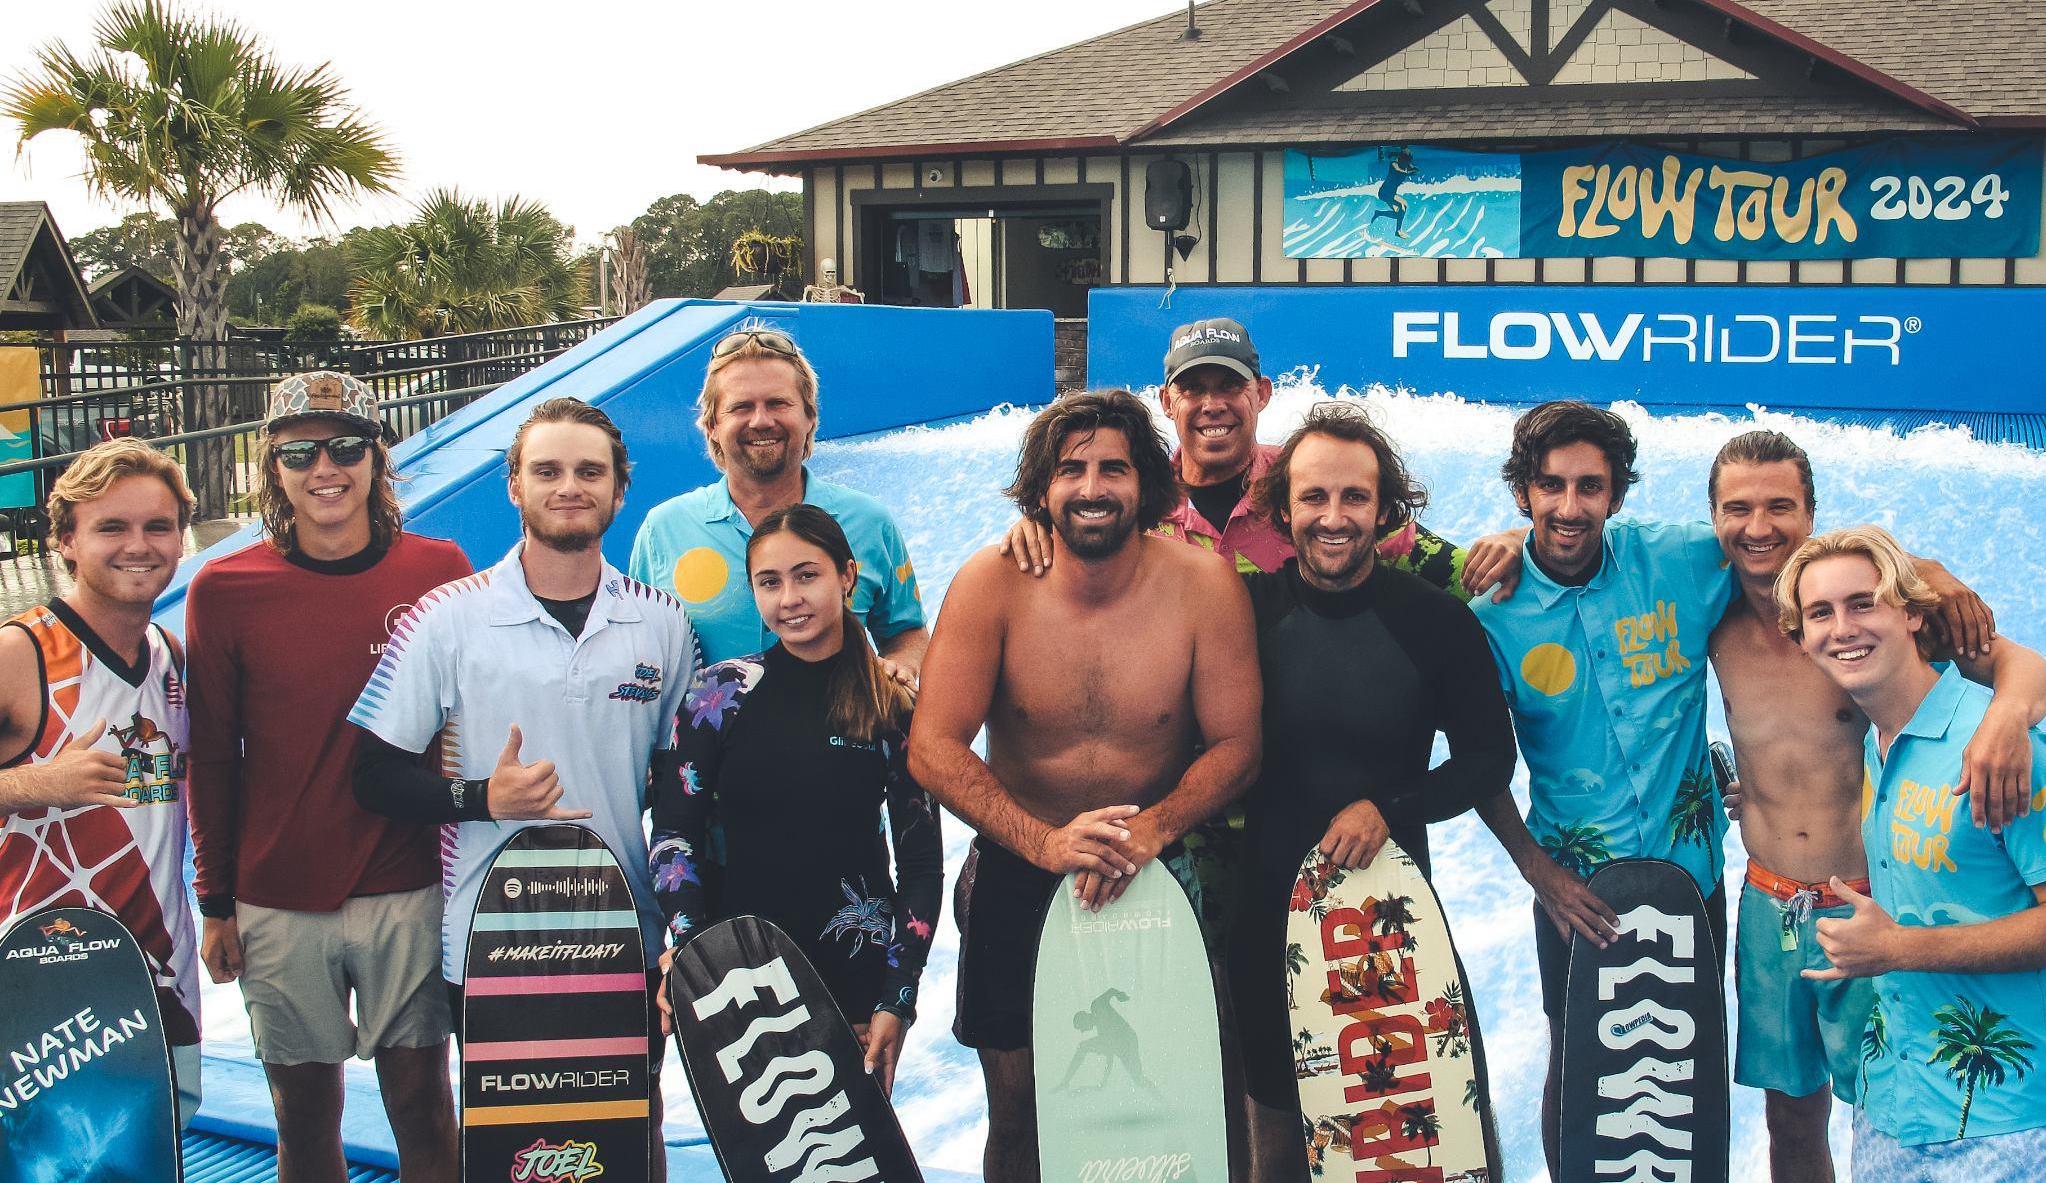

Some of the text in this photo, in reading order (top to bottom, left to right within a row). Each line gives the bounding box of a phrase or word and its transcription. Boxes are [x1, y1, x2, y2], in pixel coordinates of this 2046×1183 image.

[1557, 154, 2011, 245] FLOW TOUR 2024
[1174, 328, 1240, 351] AQUA FLOW
[1190, 337, 1220, 347] BOARDS
[1615, 600, 1679, 655] FLOW
[1623, 640, 1691, 688] TOUR
[1892, 779, 1961, 834] FLOW
[1891, 823, 1958, 873] TOUR
[6, 938, 121, 960] AQUA FLOW
[39, 953, 89, 965] BOARDS
[0, 1009, 149, 1118] NEWMAN
[10, 1006, 102, 1073] NATE
[481, 1069, 630, 1092] FLOWRIDER
[512, 1138, 604, 1183] JOEL
